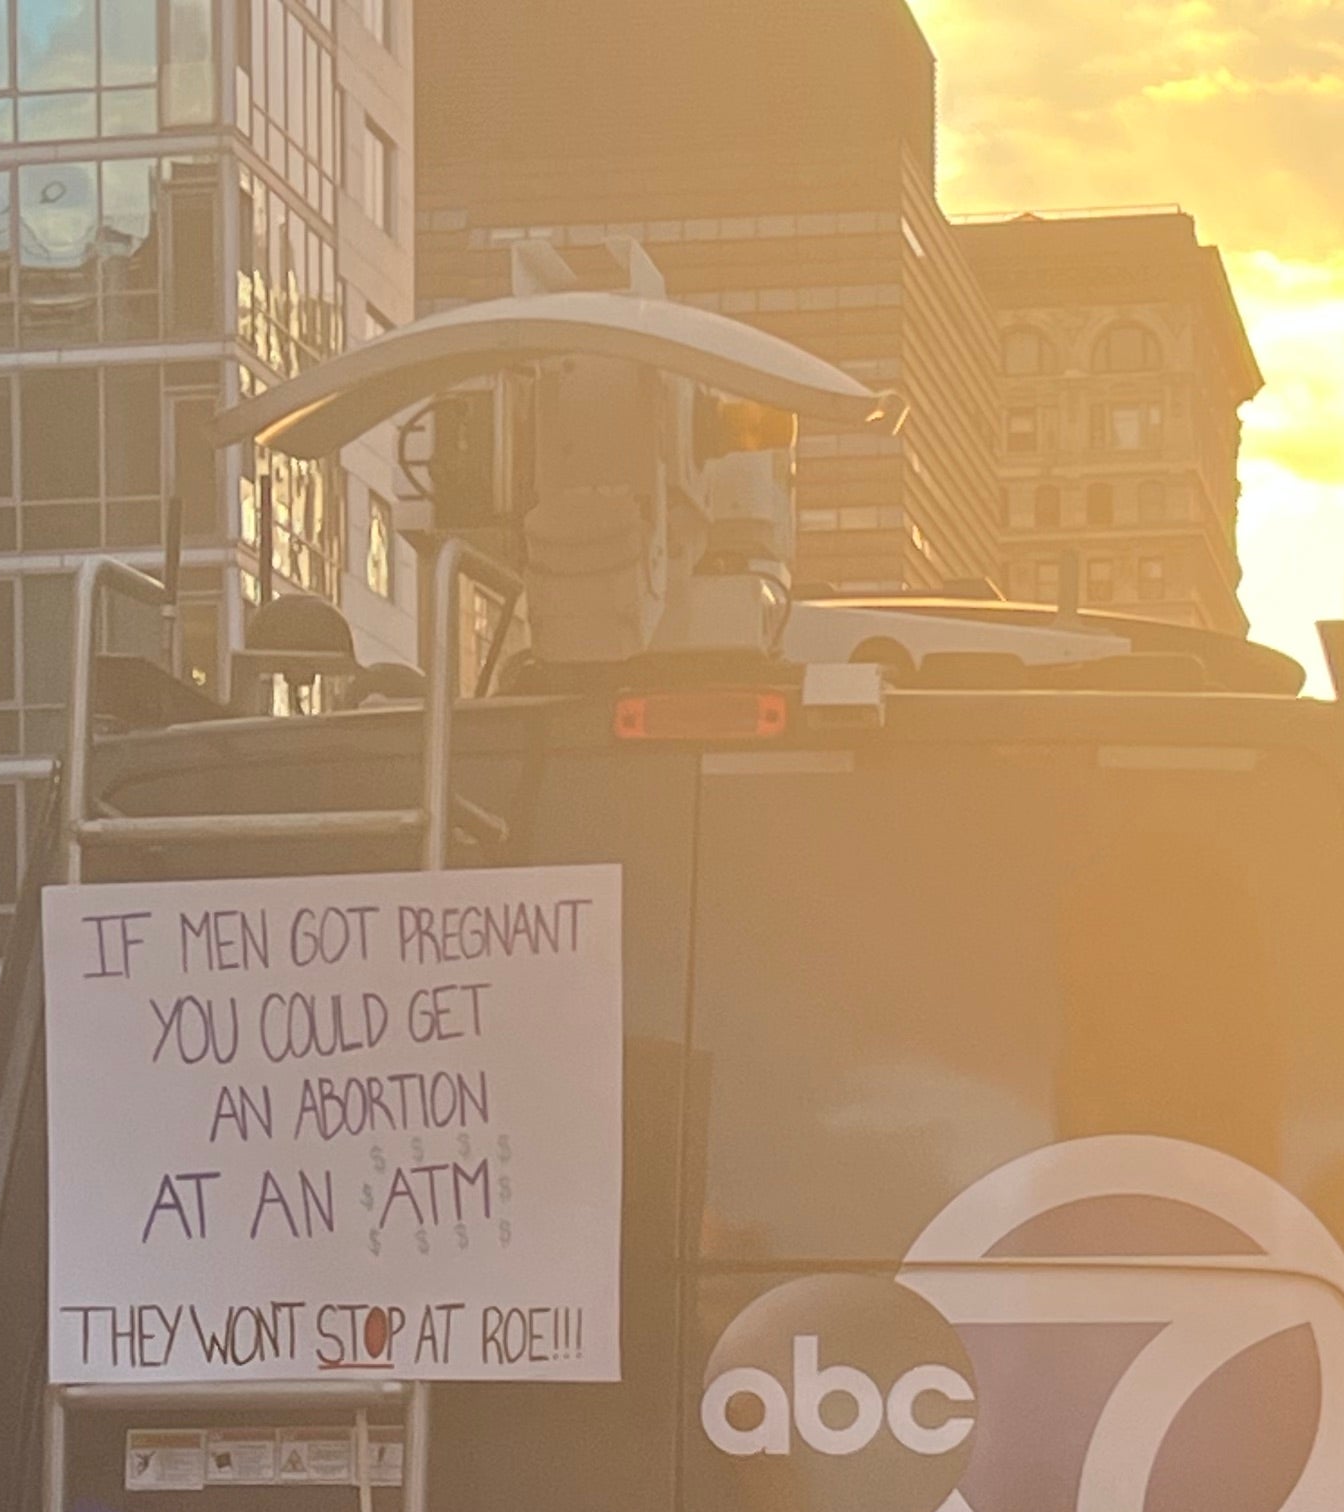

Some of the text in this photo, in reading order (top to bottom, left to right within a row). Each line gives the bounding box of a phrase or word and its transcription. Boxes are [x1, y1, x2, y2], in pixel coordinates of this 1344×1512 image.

[82, 898, 594, 979] IF MEN GOT PREGNANT
[150, 982, 493, 1065] YOU COULD GET
[209, 1071, 490, 1144] AN ABORTION
[142, 1157, 492, 1245] AT AN ATM
[59, 1300, 584, 1368] THEY WONT STOP AT ROE!!!
[700, 1335, 976, 1456] abc
